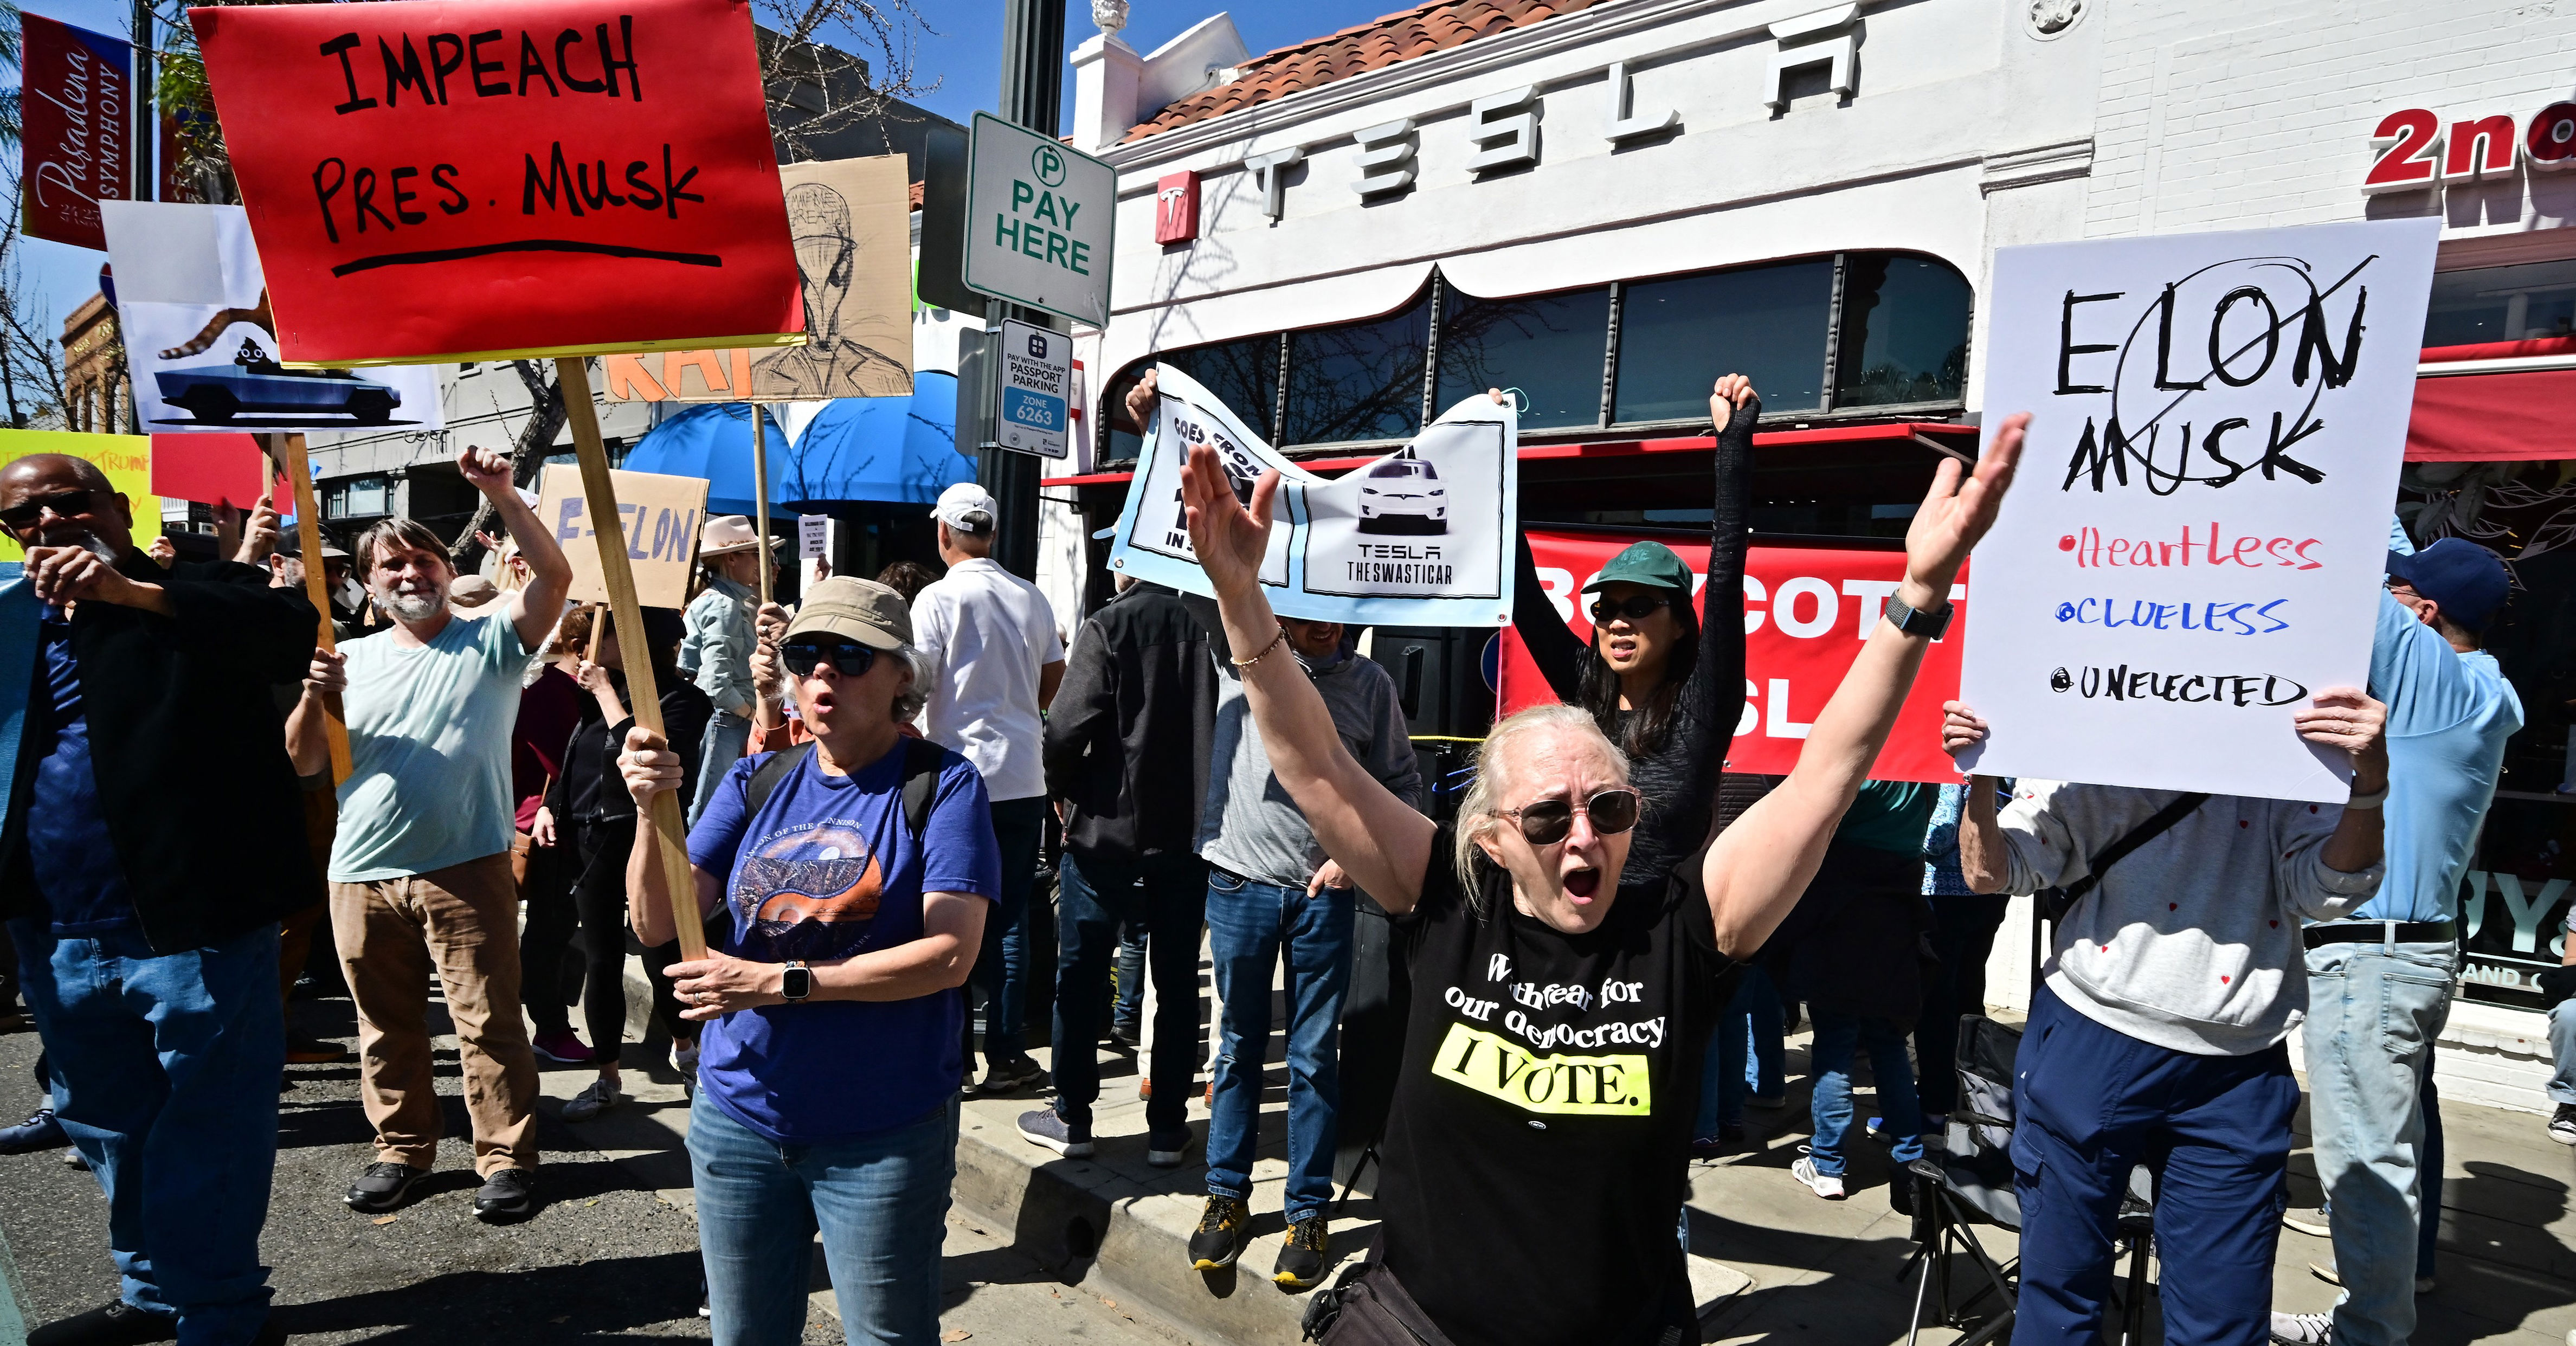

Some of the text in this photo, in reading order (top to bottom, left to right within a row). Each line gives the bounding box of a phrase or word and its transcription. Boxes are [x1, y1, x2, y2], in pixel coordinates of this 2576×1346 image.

[320, 15, 642, 115] IMPEACH
[35, 43, 100, 208] Pasadena
[100, 63, 120, 198] SYMPHONY
[1245, 3, 1862, 217] TESLA
[1042, 150, 1060, 178] P
[312, 141, 704, 243] PRES. Musk
[1012, 179, 1080, 231] PAY
[995, 214, 1090, 276] HERE
[2052, 282, 2367, 396] ELON
[1007, 353, 1020, 362] PAY
[1021, 356, 1039, 366] WITH
[1040, 362, 1052, 370] THE
[1010, 362, 1062, 383] PASSPORT
[1013, 374, 1058, 394] PARKING
[1023, 395, 1047, 408] ZONE
[1016, 405, 1052, 425] 6263
[1174, 417, 1205, 443] GOES
[2060, 411, 2327, 495] MUSK
[1165, 531, 1184, 549] IN
[1357, 544, 1440, 559] TESLA
[2077, 598, 2290, 636] CLUELESS
[2081, 664, 2308, 707] UNELECTED
[742, 833, 772, 866] ANON
[774, 827, 789, 838] OF
[791, 822, 814, 832] THE
[847, 933, 871, 954] PARK
[1445, 986, 1499, 1021] our
[1487, 953, 1644, 1012] Wth fear for
[1452, 1037, 1639, 1106] I VOTE.
